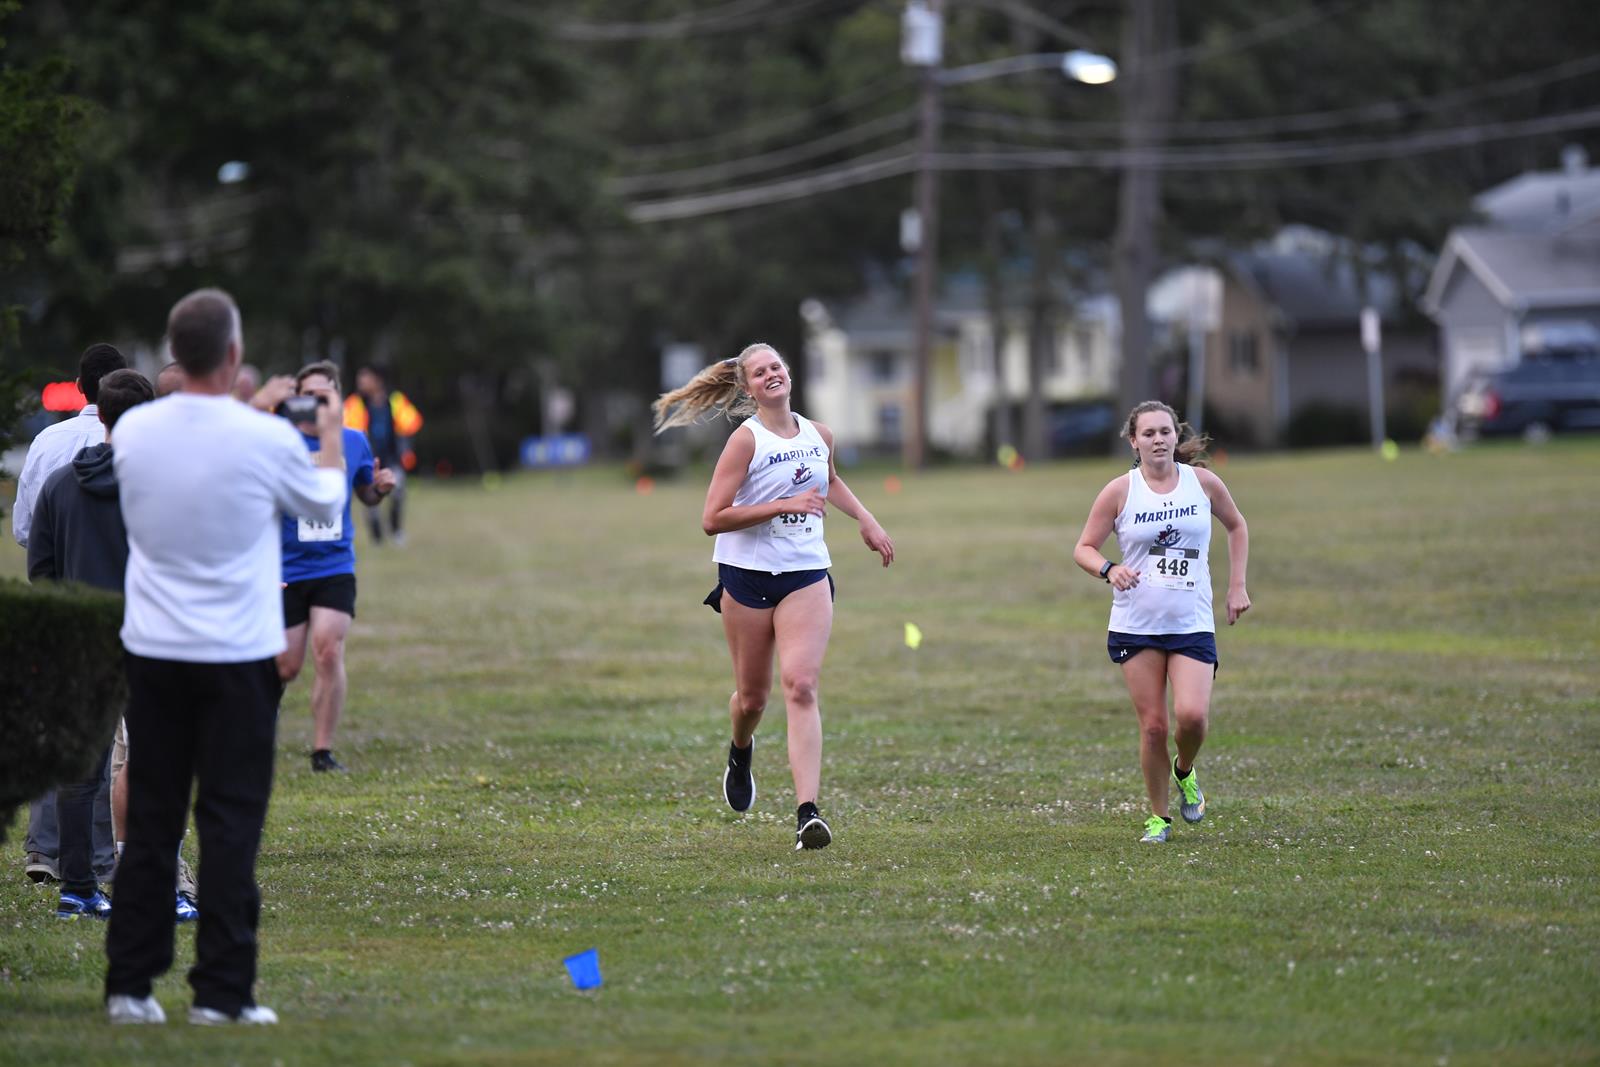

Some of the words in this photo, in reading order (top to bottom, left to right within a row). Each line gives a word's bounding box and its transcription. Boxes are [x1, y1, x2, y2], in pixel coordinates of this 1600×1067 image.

[768, 447, 822, 465] MARITIME
[1134, 504, 1198, 524] MARITIME
[1156, 557, 1189, 576] 448
